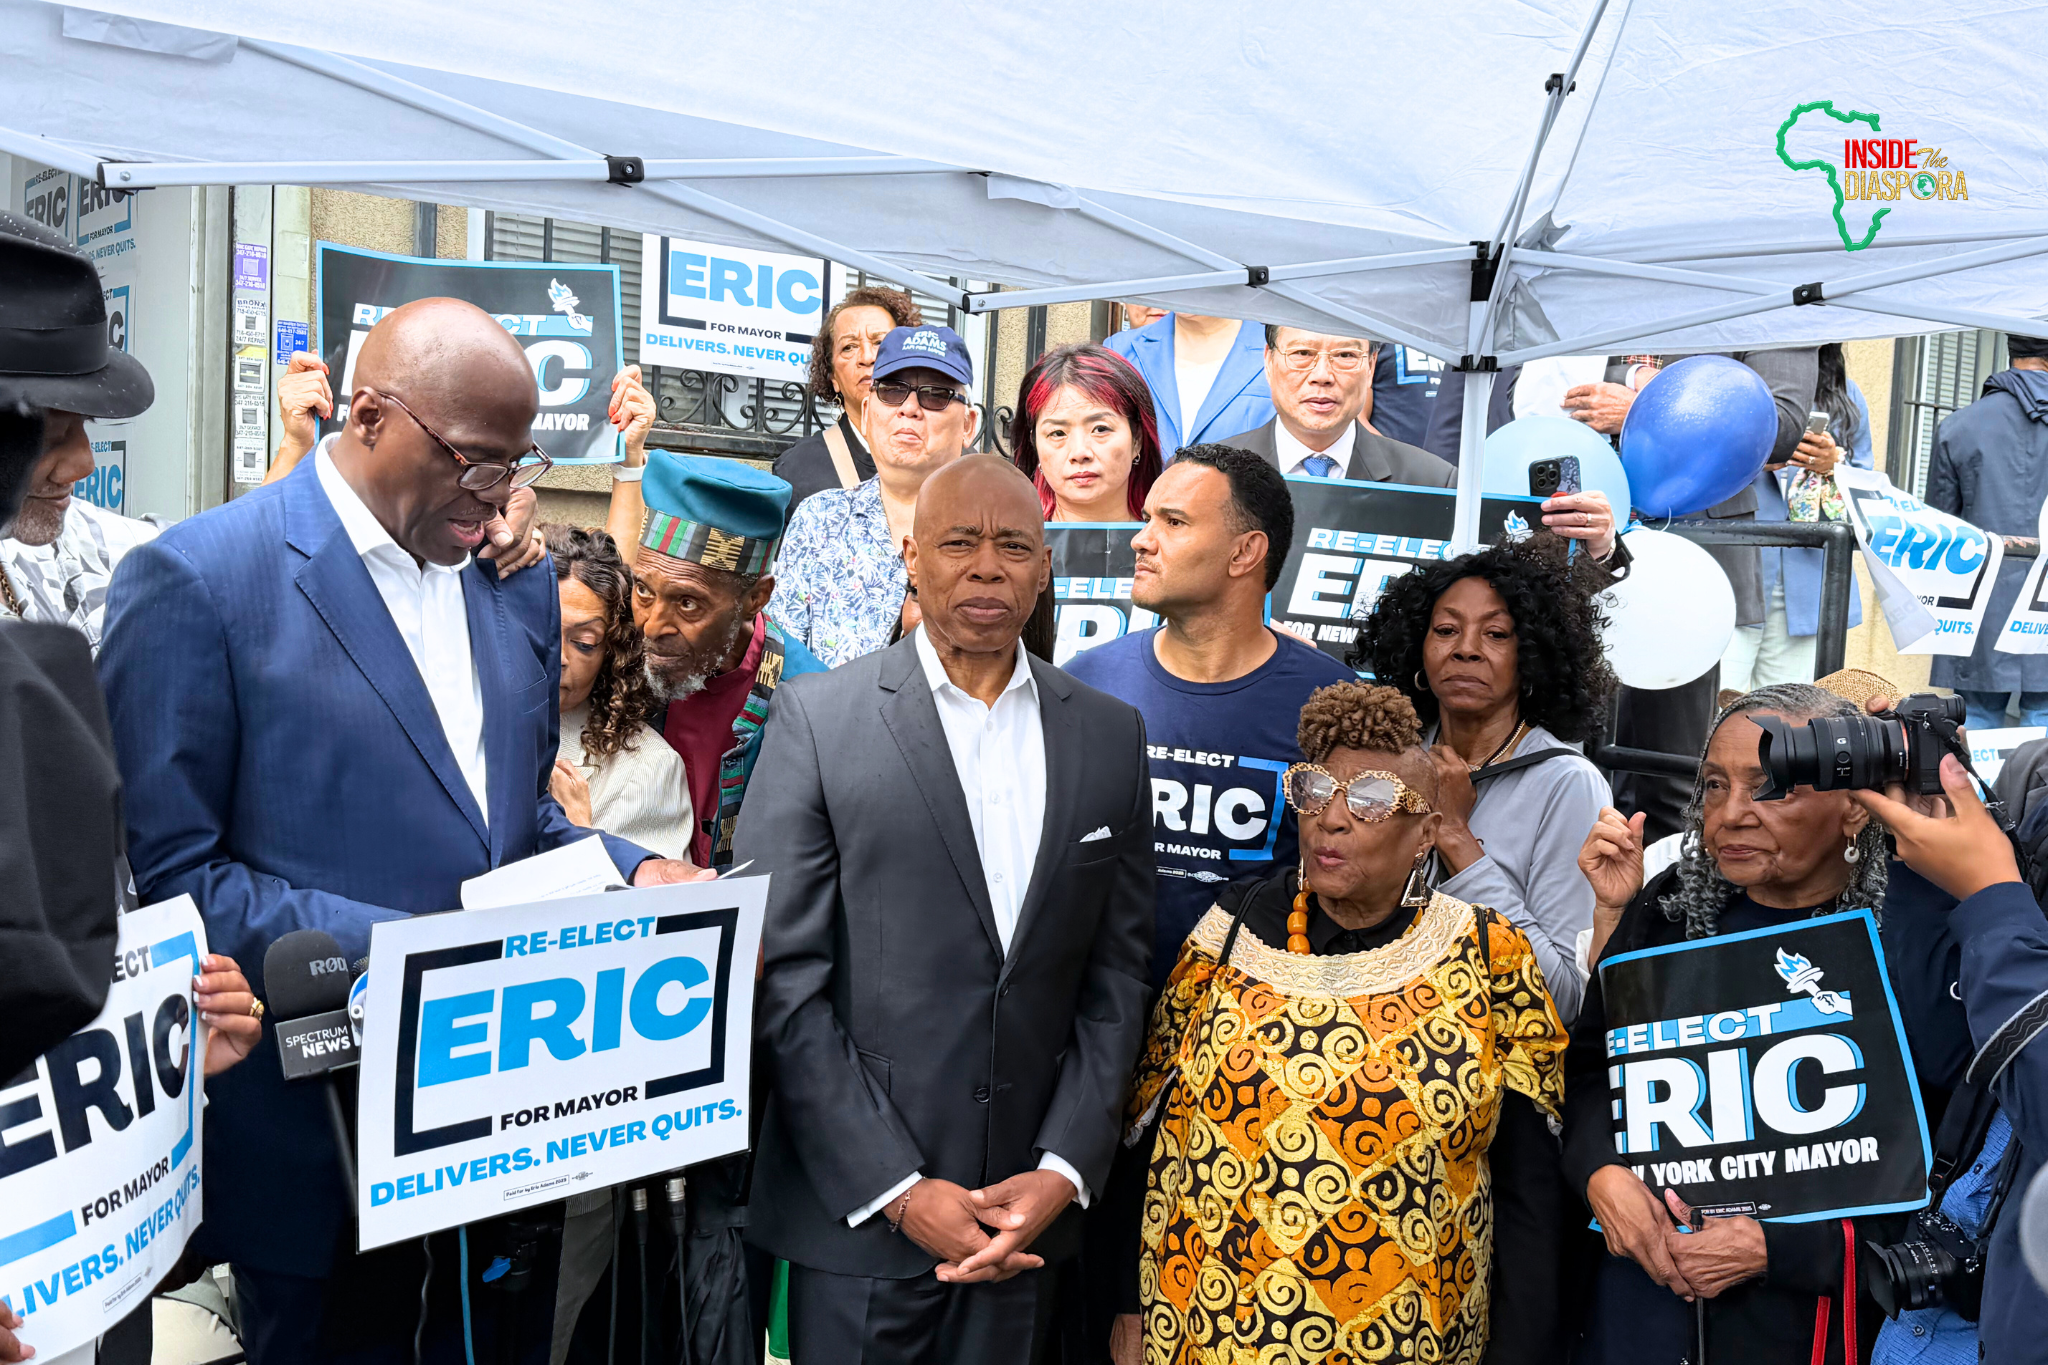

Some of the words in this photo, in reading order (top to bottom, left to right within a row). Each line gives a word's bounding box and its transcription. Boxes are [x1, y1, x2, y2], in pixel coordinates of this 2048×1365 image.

[670, 250, 822, 315] ERIC
[645, 333, 731, 355] DELIVERS.
[733, 344, 786, 363] NEVER
[711, 322, 735, 334] FOR
[738, 326, 782, 340] MAYOR
[903, 336, 947, 352] ADAMS
[914, 330, 939, 339] ERIC
[1866, 515, 1985, 575] ERIC
[1316, 624, 1360, 644] NEW
[2009, 620, 2048, 635] DELIVE
[1146, 745, 1235, 768] RE-ELECT
[1150, 777, 1268, 841] RIC
[1166, 843, 1222, 860] MAYOR
[504, 916, 656, 959] RE-ELECT
[309, 956, 348, 977] RØD
[285, 1025, 349, 1048] SPECTRUM
[417, 956, 713, 1089] ERIC
[1605, 1002, 1782, 1059] E-ELECT
[301, 1036, 351, 1058] NEWS
[500, 1105, 550, 1131] FOR
[554, 1085, 638, 1119] MAYOR
[370, 1147, 541, 1208] DELIVERS.
[546, 1120, 647, 1163] NEVER
[651, 1098, 742, 1141] QUITS.
[1650, 1157, 1715, 1187] YORK
[1720, 1150, 1776, 1181] CITY
[1785, 1136, 1880, 1173] MAYOR
[81, 1188, 123, 1227] FOR
[123, 1156, 169, 1204] MAYOR
[0, 1243, 124, 1318] LIVERS.
[125, 1197, 174, 1260] NEVER
[174, 1164, 200, 1220] QUITS.
